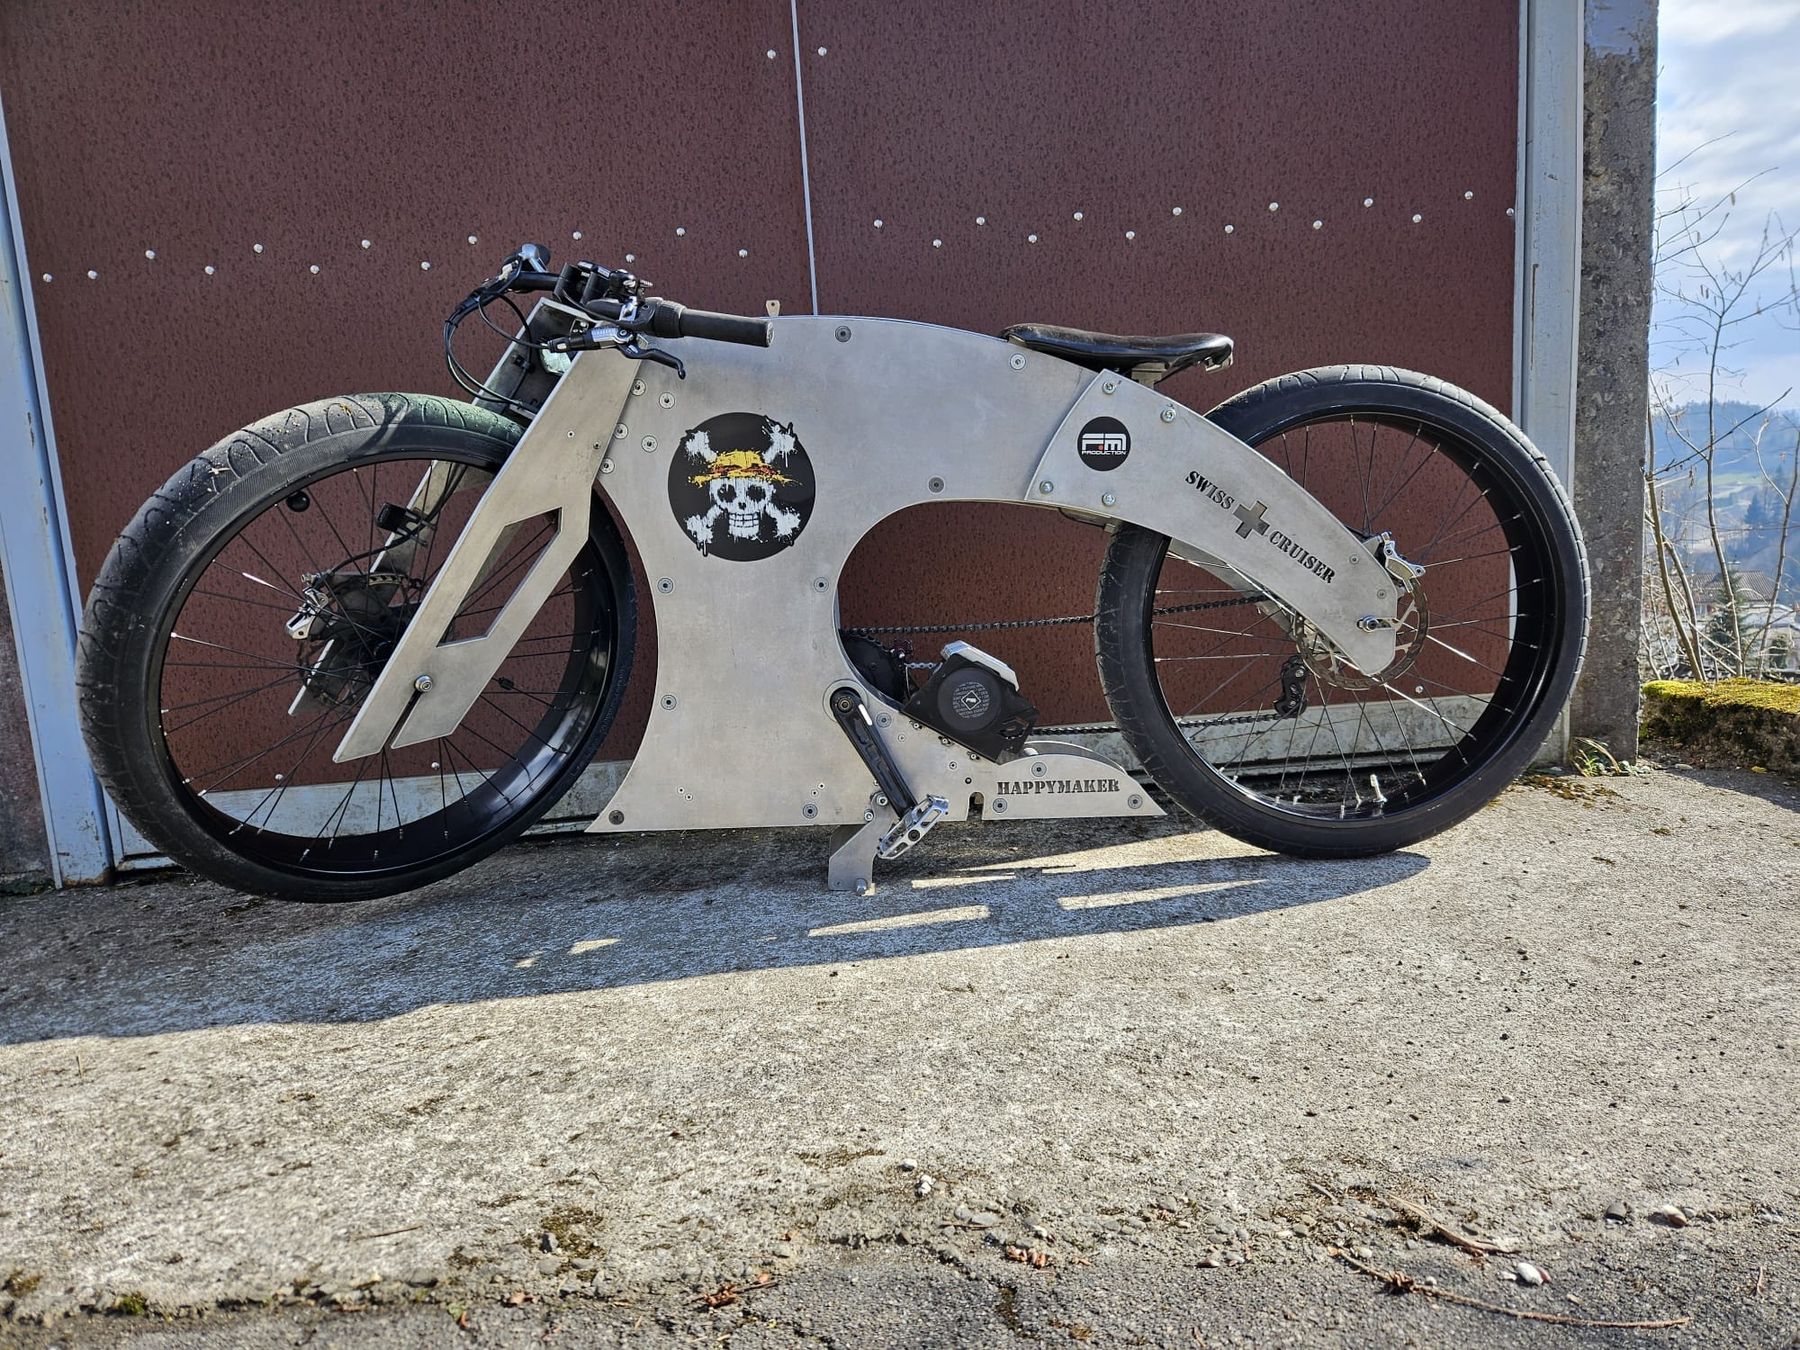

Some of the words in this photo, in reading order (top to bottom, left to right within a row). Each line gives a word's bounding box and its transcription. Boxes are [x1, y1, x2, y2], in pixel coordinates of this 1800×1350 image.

[1184, 470, 1235, 510] SWISS
[1269, 530, 1336, 584] CRUISER
[997, 778, 1121, 795] HAPPYMAKER
